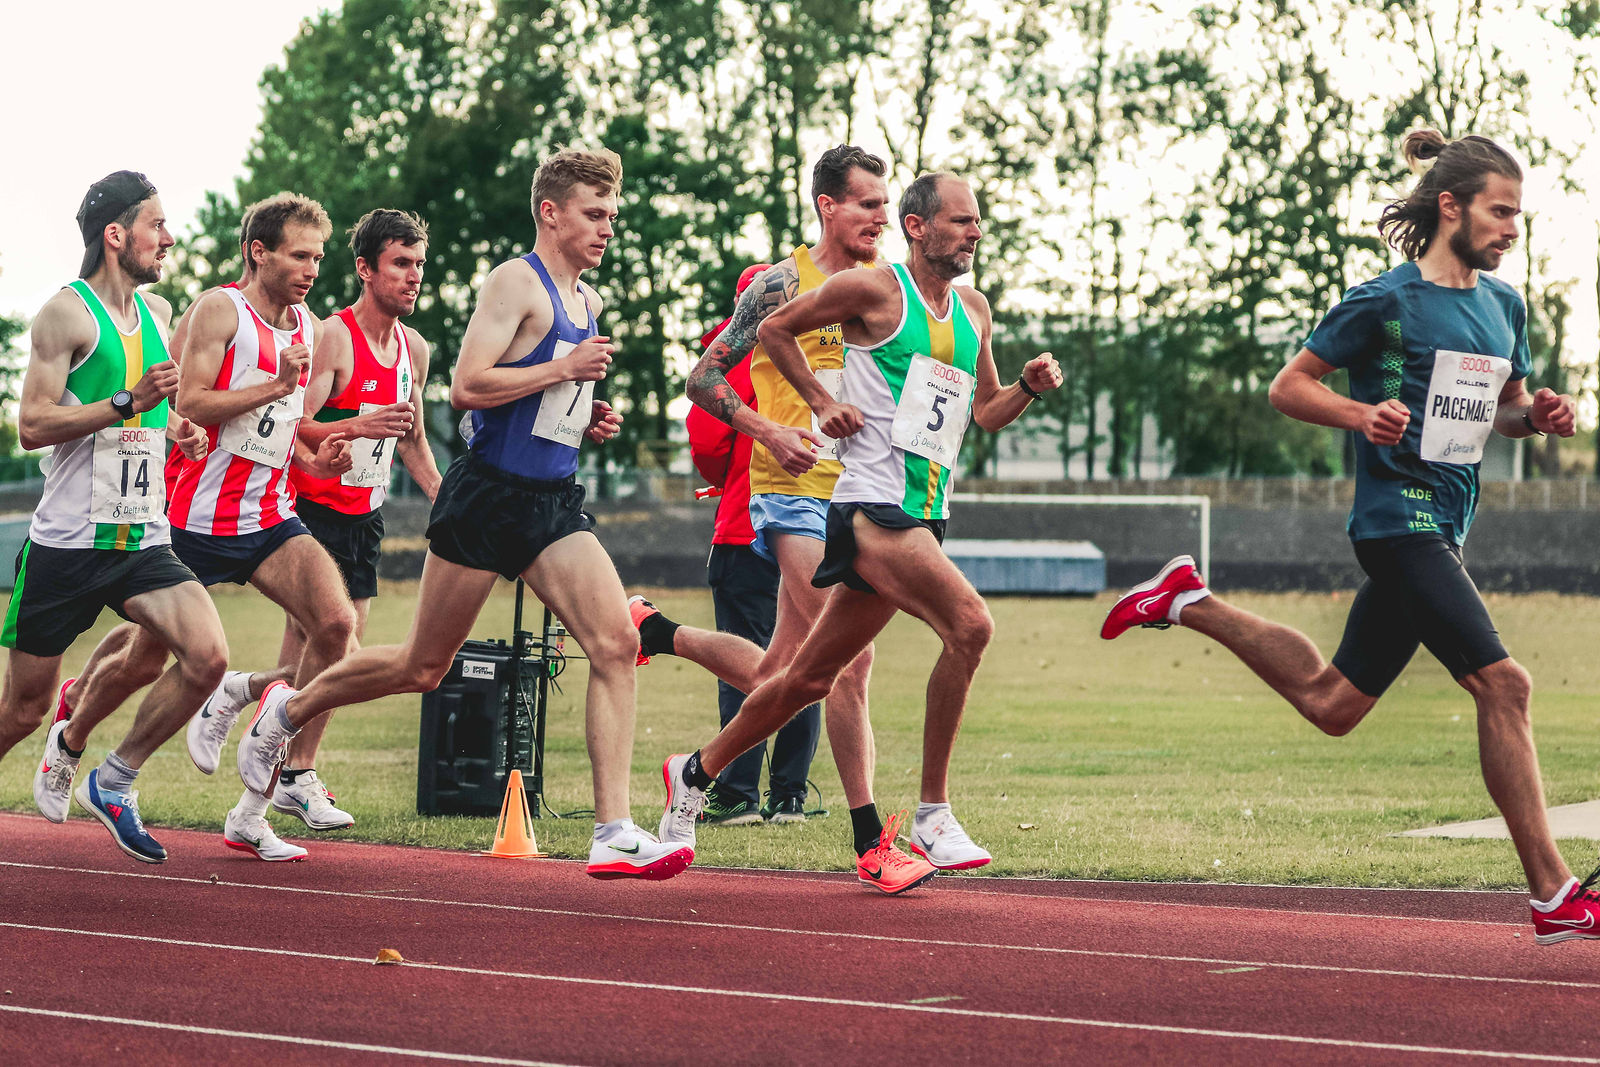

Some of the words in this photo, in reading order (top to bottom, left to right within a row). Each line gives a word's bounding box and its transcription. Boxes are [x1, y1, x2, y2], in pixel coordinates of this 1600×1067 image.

[819, 336, 828, 346] &
[257, 404, 276, 439] 6
[926, 394, 948, 432] 5
[371, 438, 386, 465] 4
[120, 459, 149, 497] 14
